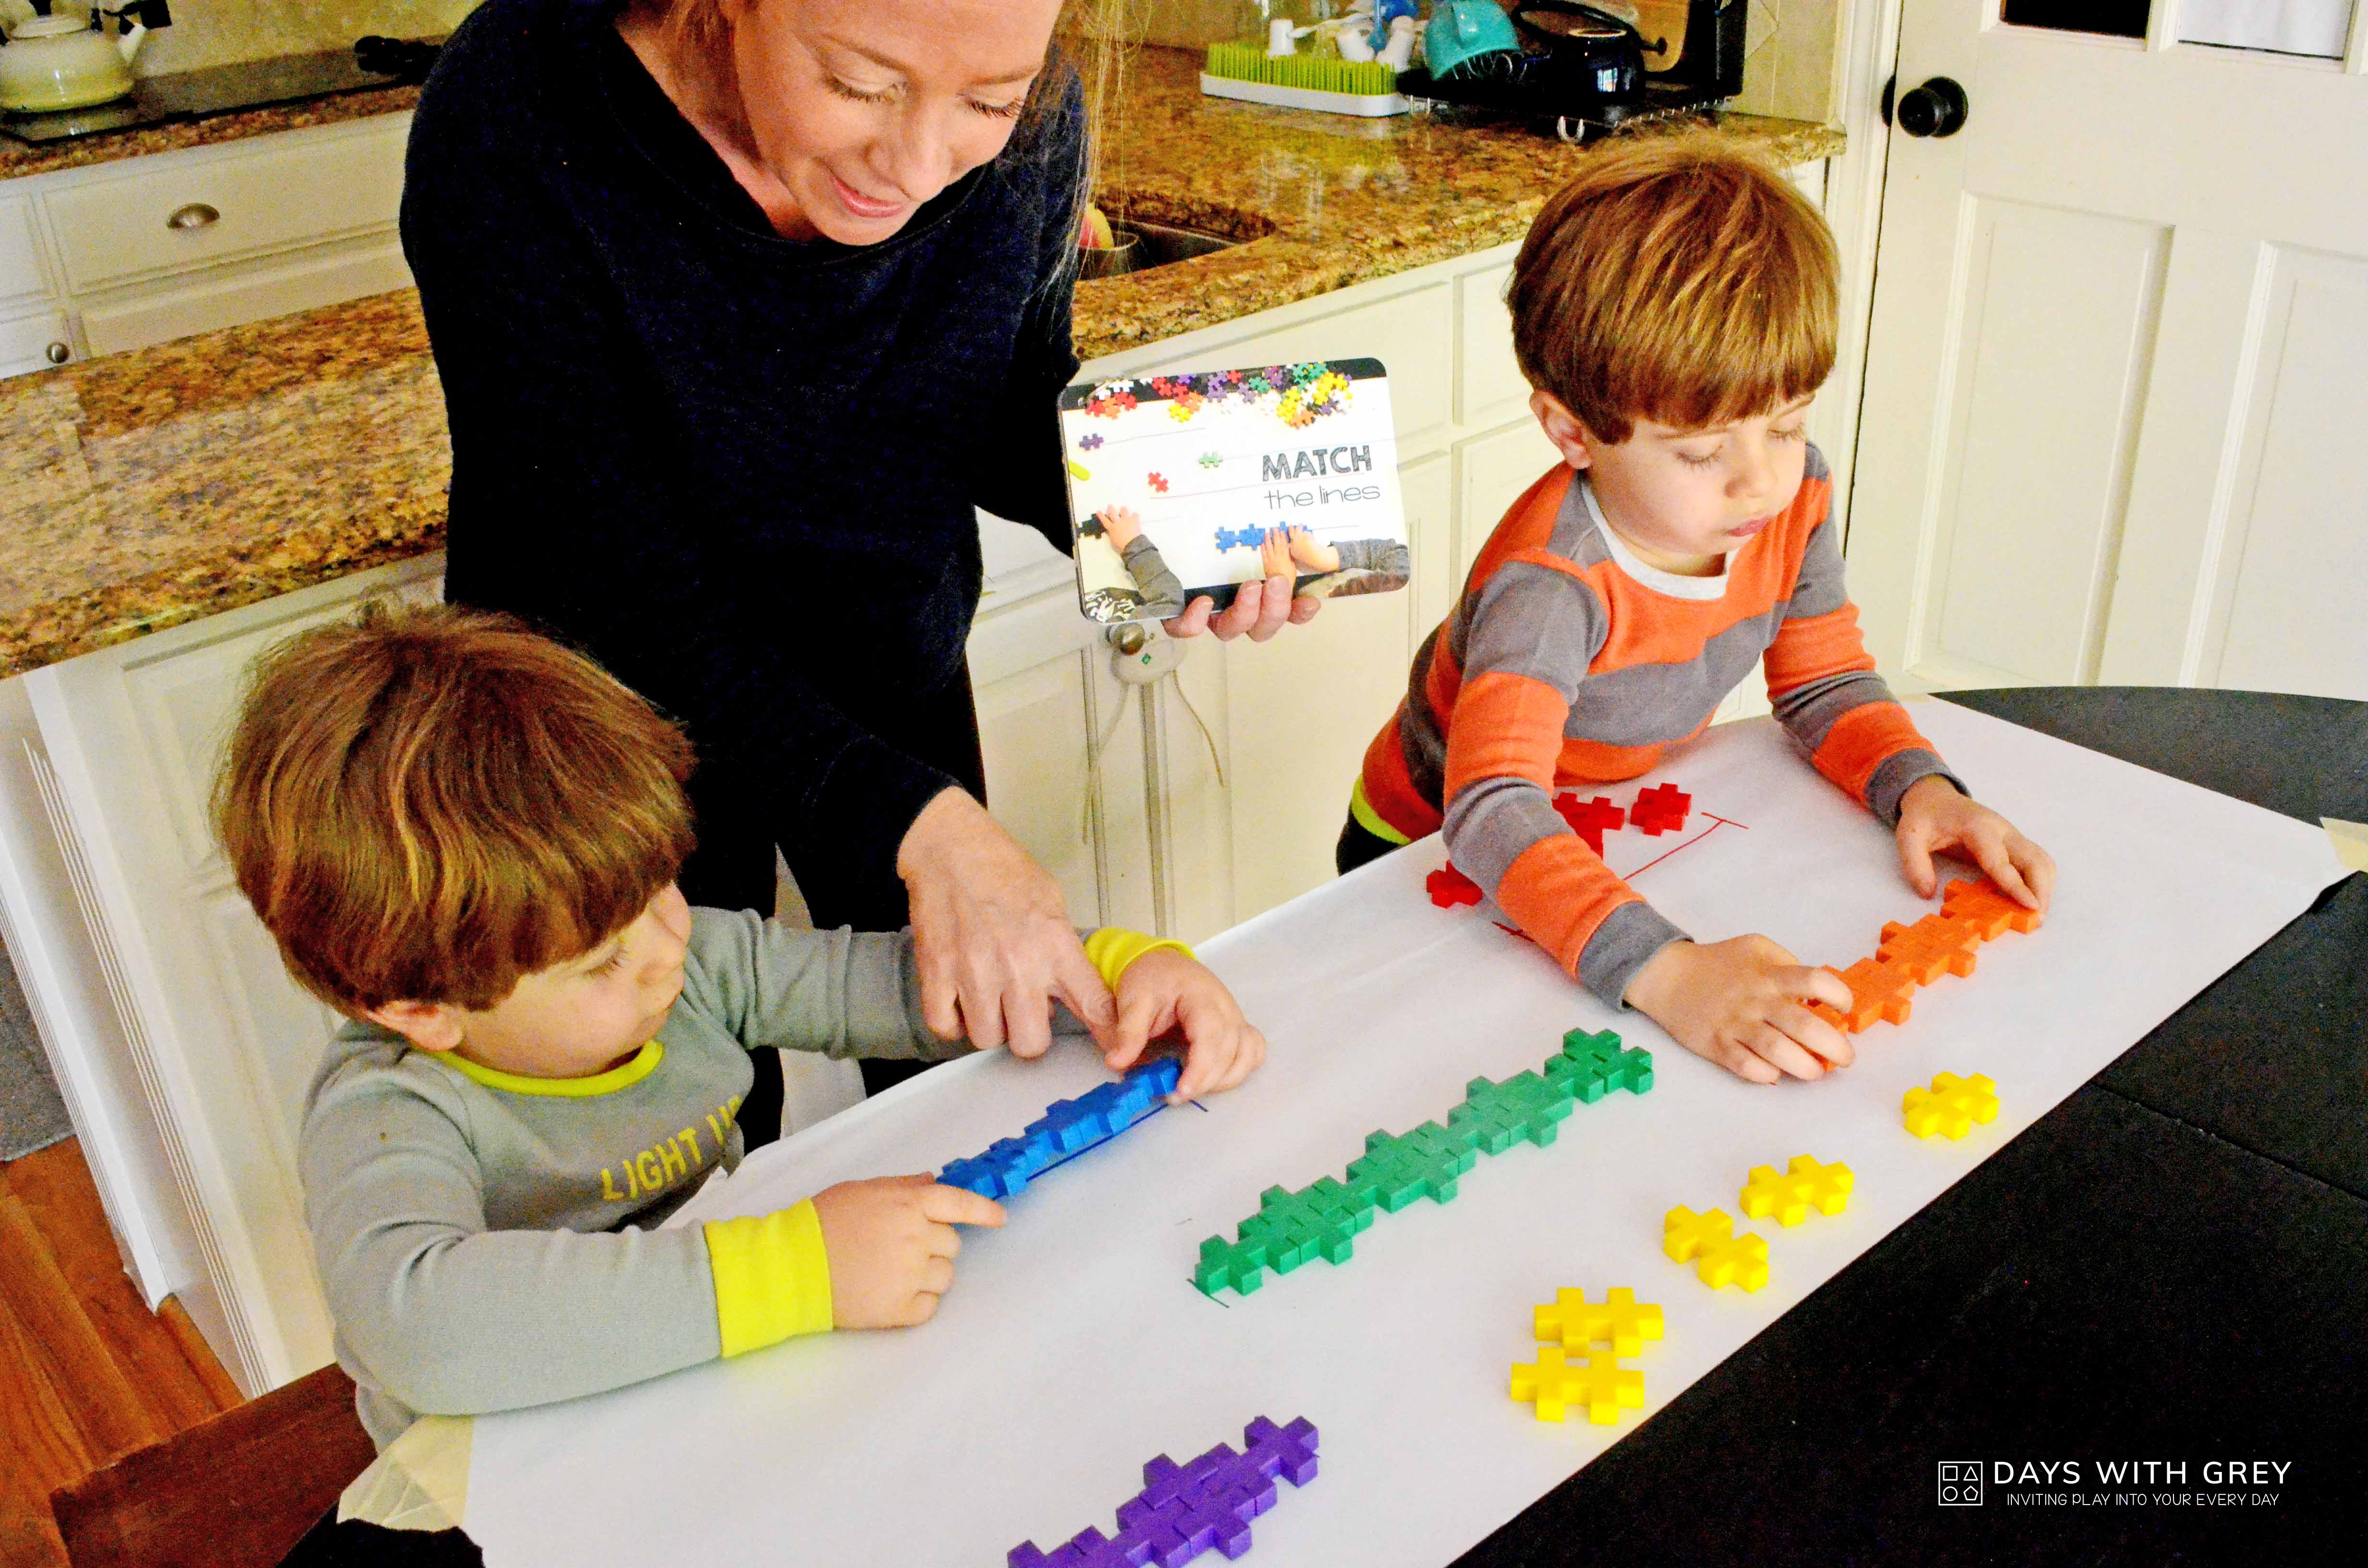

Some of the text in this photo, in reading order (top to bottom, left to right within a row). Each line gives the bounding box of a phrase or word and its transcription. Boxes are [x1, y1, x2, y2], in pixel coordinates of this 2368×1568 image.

[1262, 445, 1372, 482] MATCH
[1264, 485, 1381, 510] the lines
[601, 1127, 702, 1200] LIGHT
